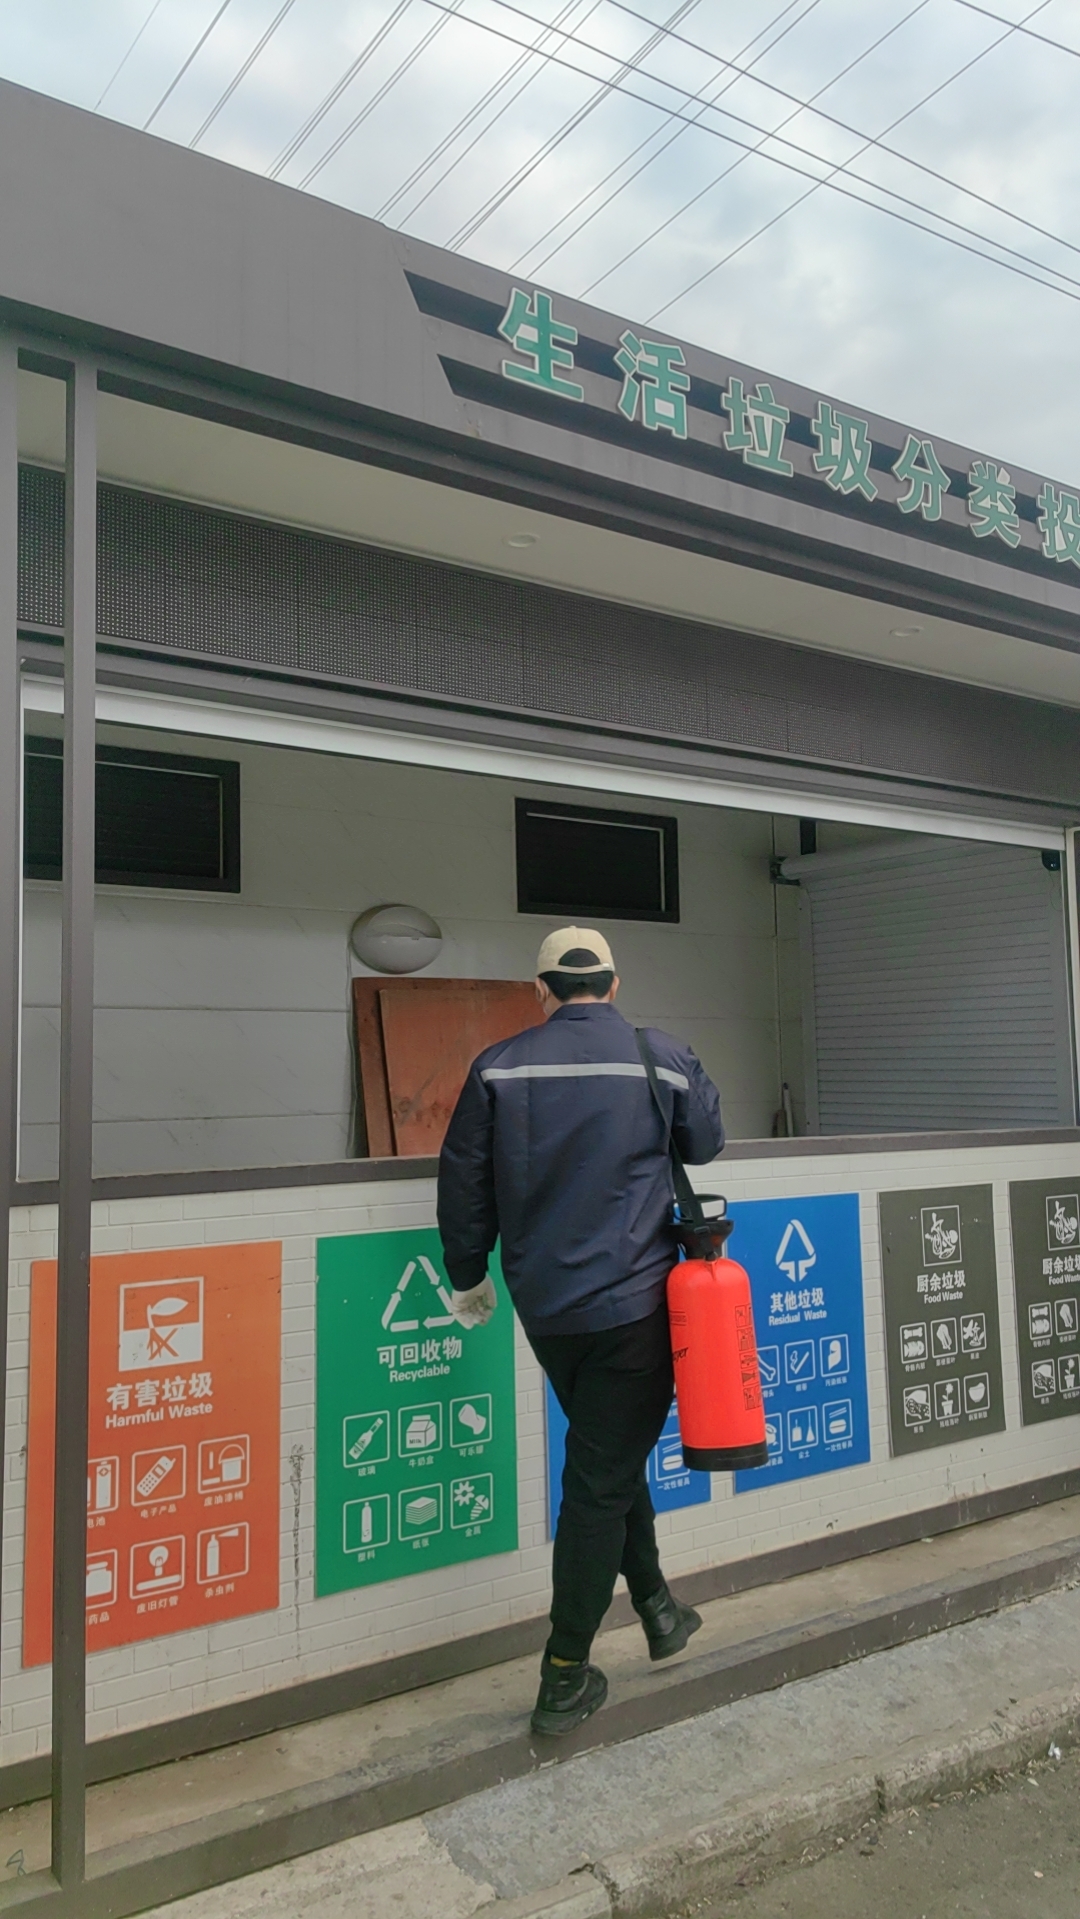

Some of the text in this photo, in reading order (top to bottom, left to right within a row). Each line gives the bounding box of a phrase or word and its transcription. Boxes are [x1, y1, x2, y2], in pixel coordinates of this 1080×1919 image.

[498, 287, 1080, 570] 生活垃圾分类投
[916, 1269, 967, 1293] 厨余垃圾
[1048, 1273, 1080, 1286] Food Wast
[770, 1287, 825, 1314] 其他垃圾
[923, 1290, 964, 1304] Food Waste
[768, 1309, 828, 1327] Residual Waste
[376, 1336, 463, 1369] 可回收物
[389, 1363, 451, 1383] Recyclable
[106, 1372, 213, 1411] 有害垃圾
[105, 1402, 213, 1429] Harmful Waste
[408, 1455, 435, 1468] 牛奶盒
[357, 1465, 376, 1477] 玻璃
[656, 1476, 691, 1491] 一次性餐具
[140, 1503, 177, 1519] 电子产品
[464, 1525, 482, 1538] 金属
[204, 1582, 236, 1598] 杀虫剂
[136, 1595, 179, 1615] 废旧灯管
